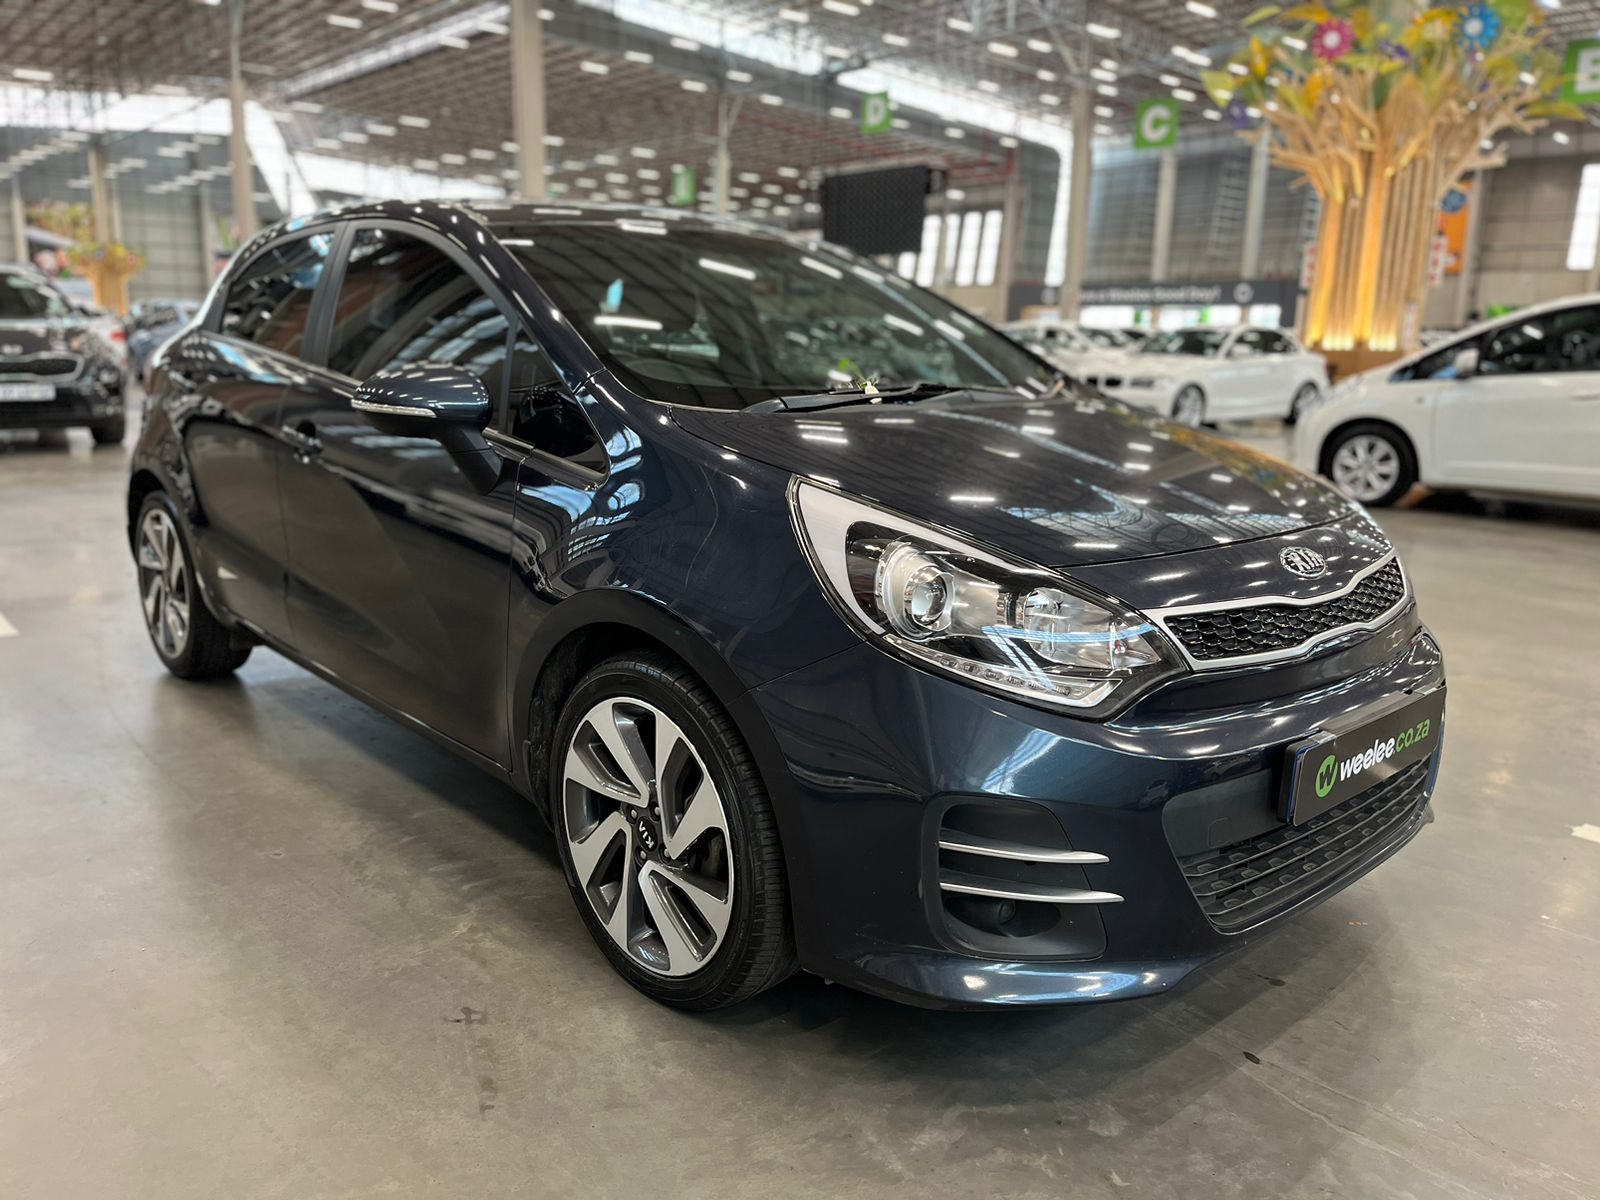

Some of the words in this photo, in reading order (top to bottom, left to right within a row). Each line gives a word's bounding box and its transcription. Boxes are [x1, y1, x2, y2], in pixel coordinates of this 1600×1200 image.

[865, 98, 886, 126] D
[1141, 104, 1171, 143] C
[1284, 549, 1325, 573] KIA
[639, 821, 655, 848] KIA
